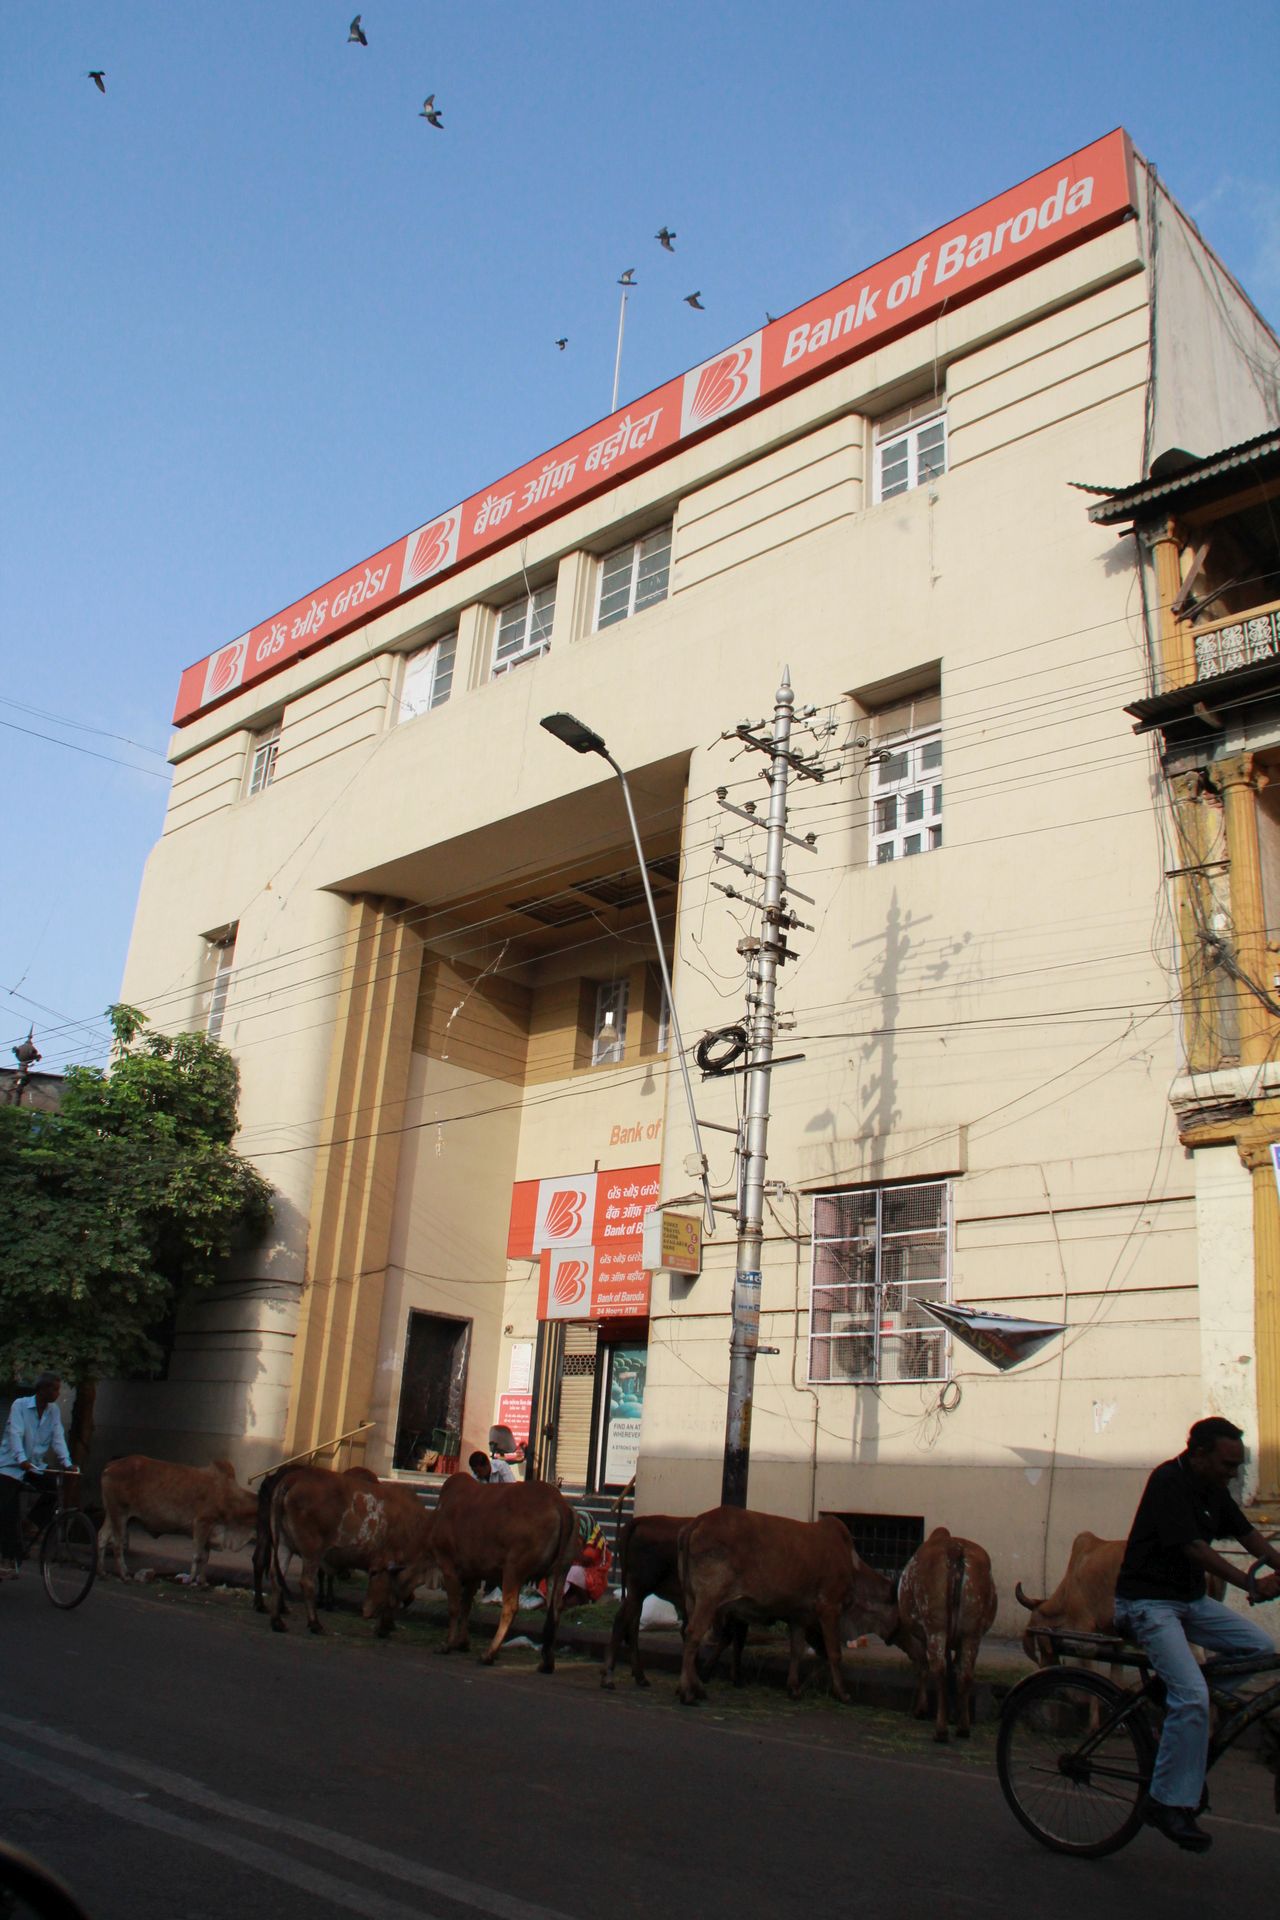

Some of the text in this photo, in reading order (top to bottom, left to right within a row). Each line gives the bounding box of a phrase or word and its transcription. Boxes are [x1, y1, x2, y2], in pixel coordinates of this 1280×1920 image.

[782, 175, 1095, 367] Bank of Baroda
[473, 406, 664, 535] बैंक ऑफ़ बड़ौदा
[255, 622, 288, 662] બેંક
[331, 562, 392, 618] બરોડા
[609, 1118, 662, 1146] Bank of
[604, 1223, 626, 1237] Bank
[626, 1222, 636, 1235] of
[597, 1290, 645, 1303] Bank of Baroda
[624, 1306, 637, 1314] ATM
